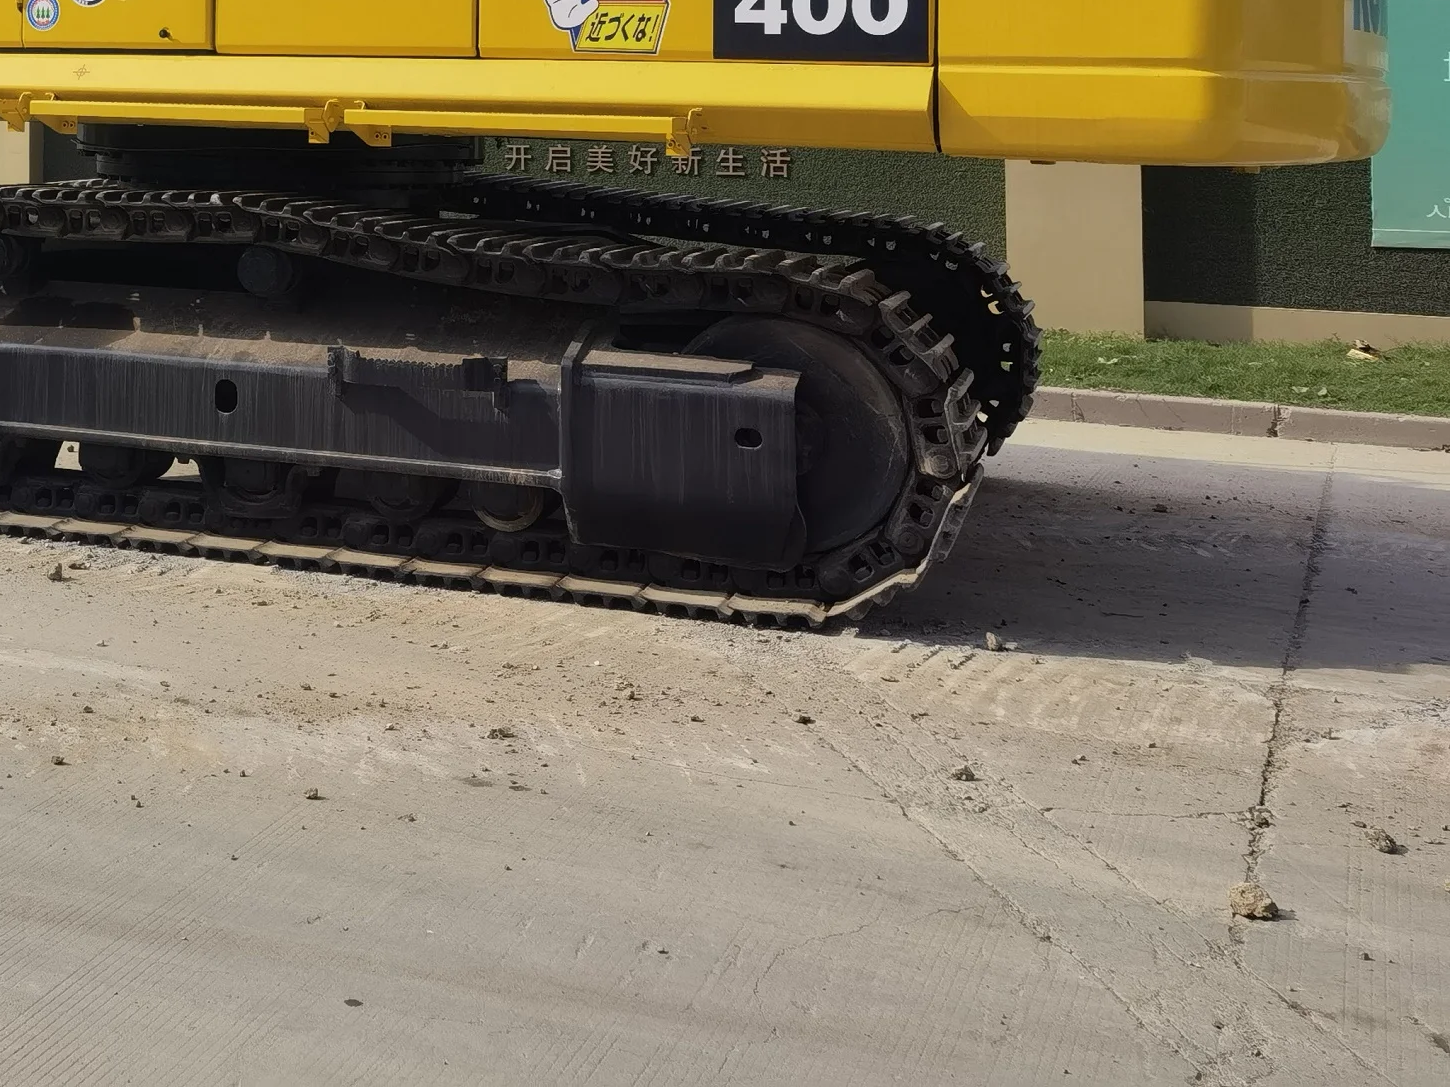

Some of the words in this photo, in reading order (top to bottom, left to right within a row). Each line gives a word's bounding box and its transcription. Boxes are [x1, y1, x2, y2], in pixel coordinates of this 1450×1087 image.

[585, 12, 660, 43] 近づくな!
[504, 143, 791, 178] 开启美好新生活
